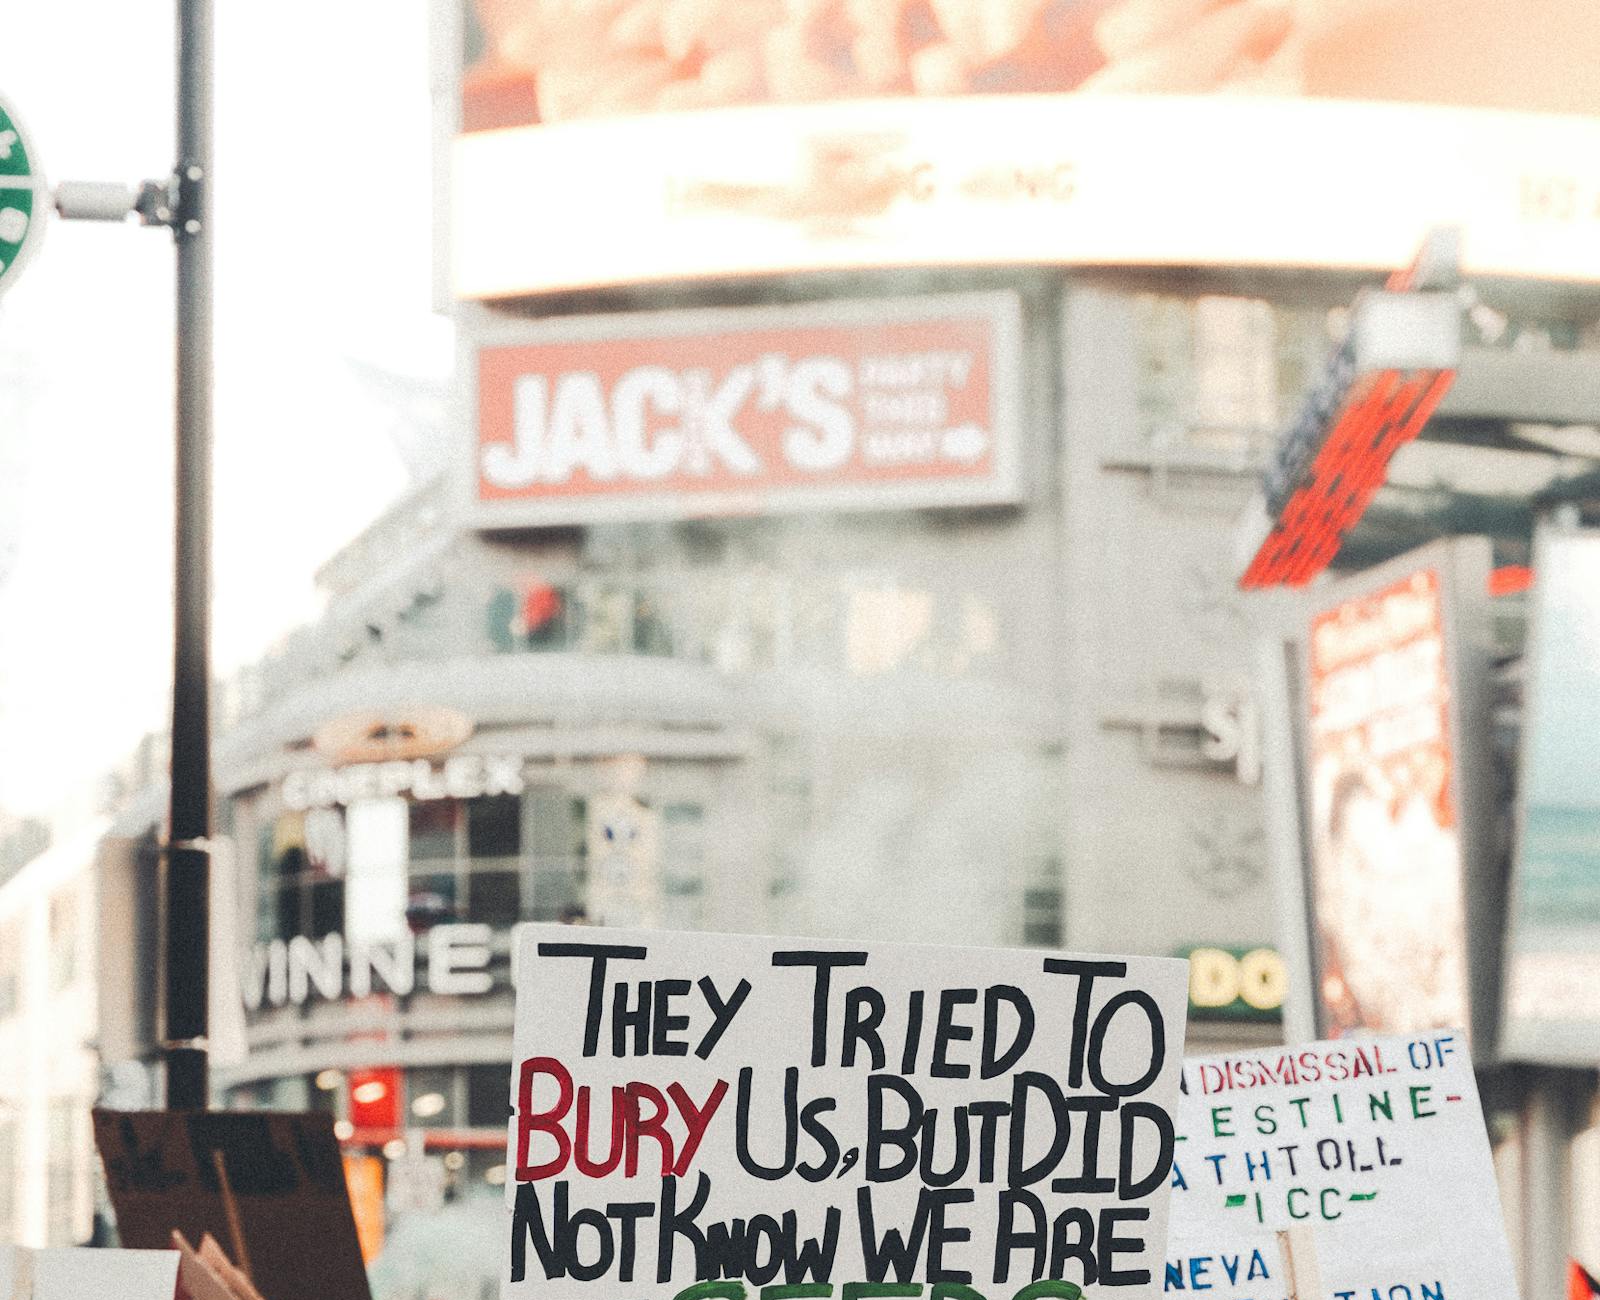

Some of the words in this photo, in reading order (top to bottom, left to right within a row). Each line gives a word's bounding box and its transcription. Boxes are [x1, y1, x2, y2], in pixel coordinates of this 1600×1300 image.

[482, 350, 856, 488] JACK'S
[242, 922, 520, 1010] INNE
[538, 942, 752, 1060] THEY
[772, 951, 1035, 1079] TRIED
[1043, 958, 1166, 1097] TO
[1175, 1086, 1462, 1141] ESTINE-
[1199, 1046, 1397, 1094] DISMISSAL
[1408, 1037, 1454, 1069] OF
[515, 1056, 730, 1182] BURY
[865, 1074, 1011, 1187] BUT
[1008, 1071, 1175, 1199] DID
[511, 1180, 655, 1283] NOT
[657, 1170, 842, 1286] KNOW
[857, 1186, 975, 1286] WE
[993, 1187, 1151, 1286] ARE
